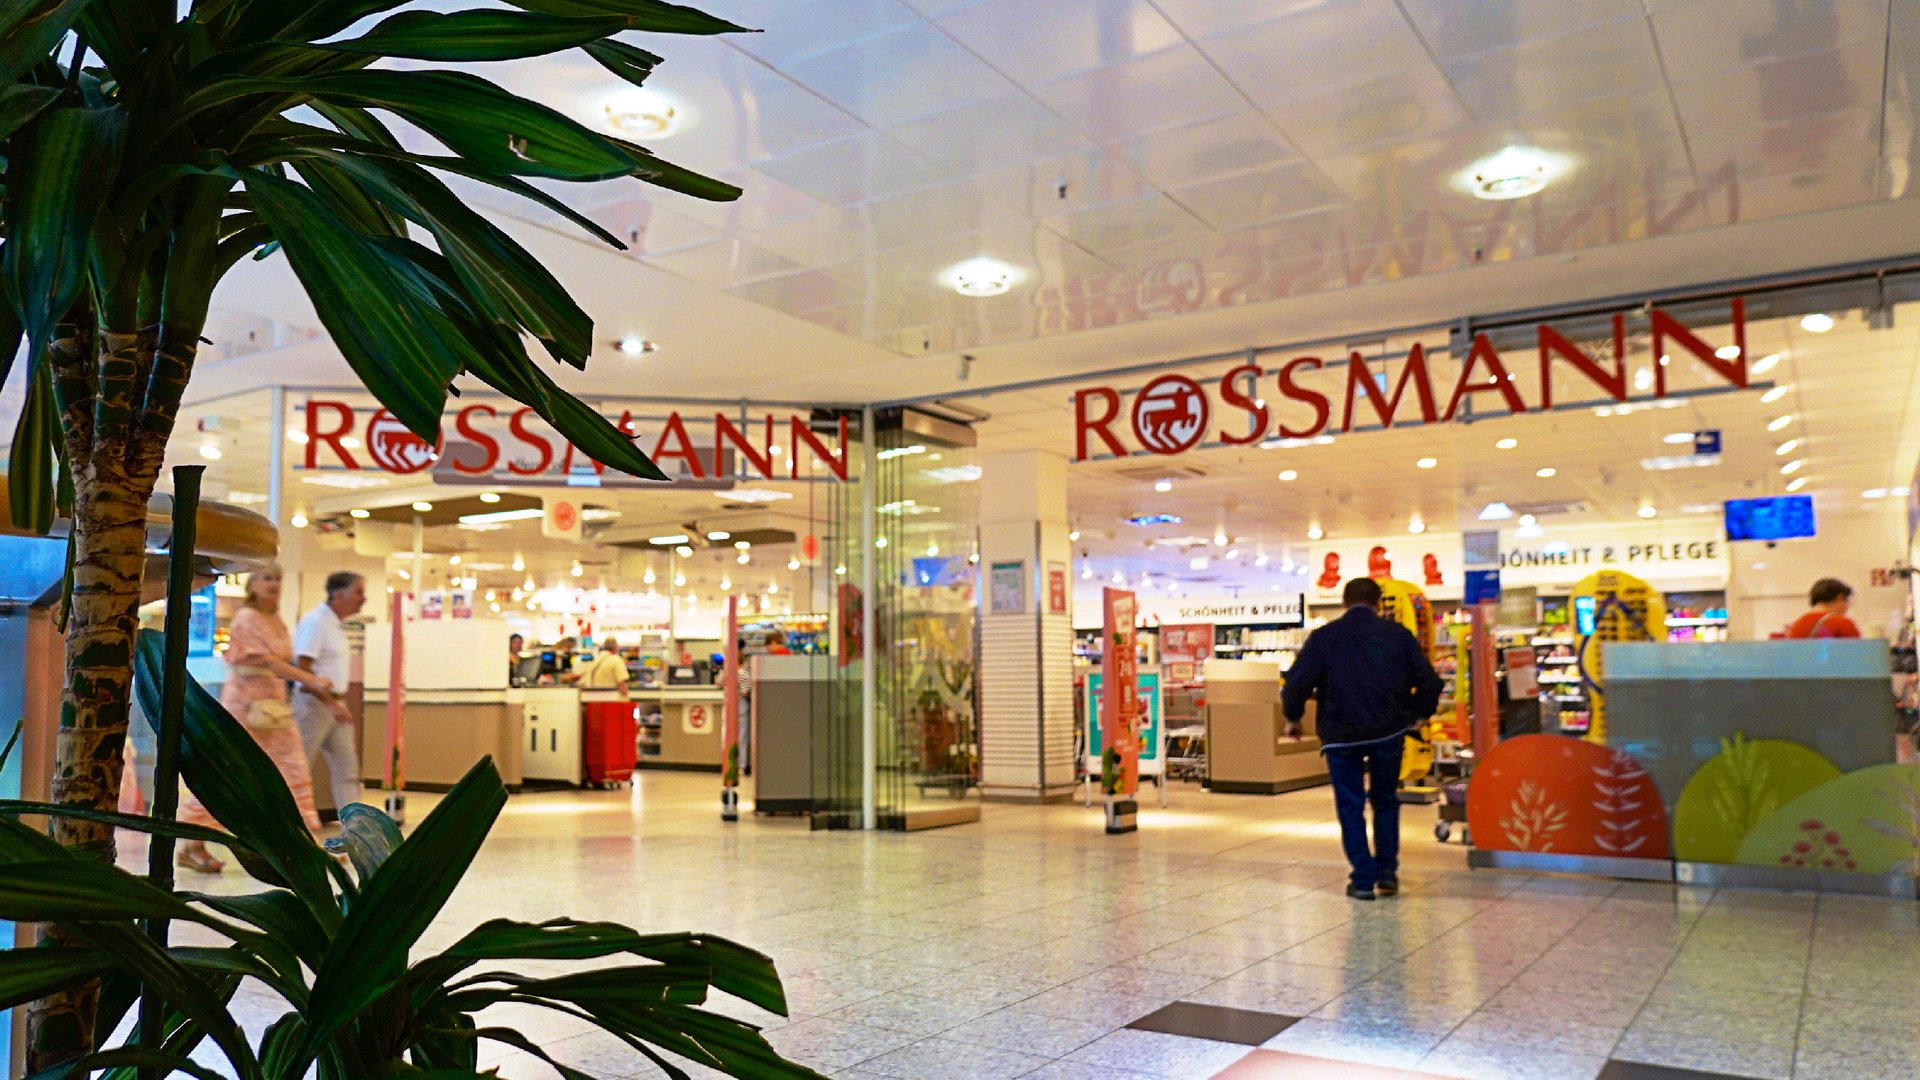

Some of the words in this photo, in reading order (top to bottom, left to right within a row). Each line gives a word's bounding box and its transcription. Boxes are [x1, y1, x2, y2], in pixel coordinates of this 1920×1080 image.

[1074, 296, 1748, 461] ROSSMANN
[1602, 547, 1618, 563] &
[1627, 541, 1719, 562] PFLEGE
